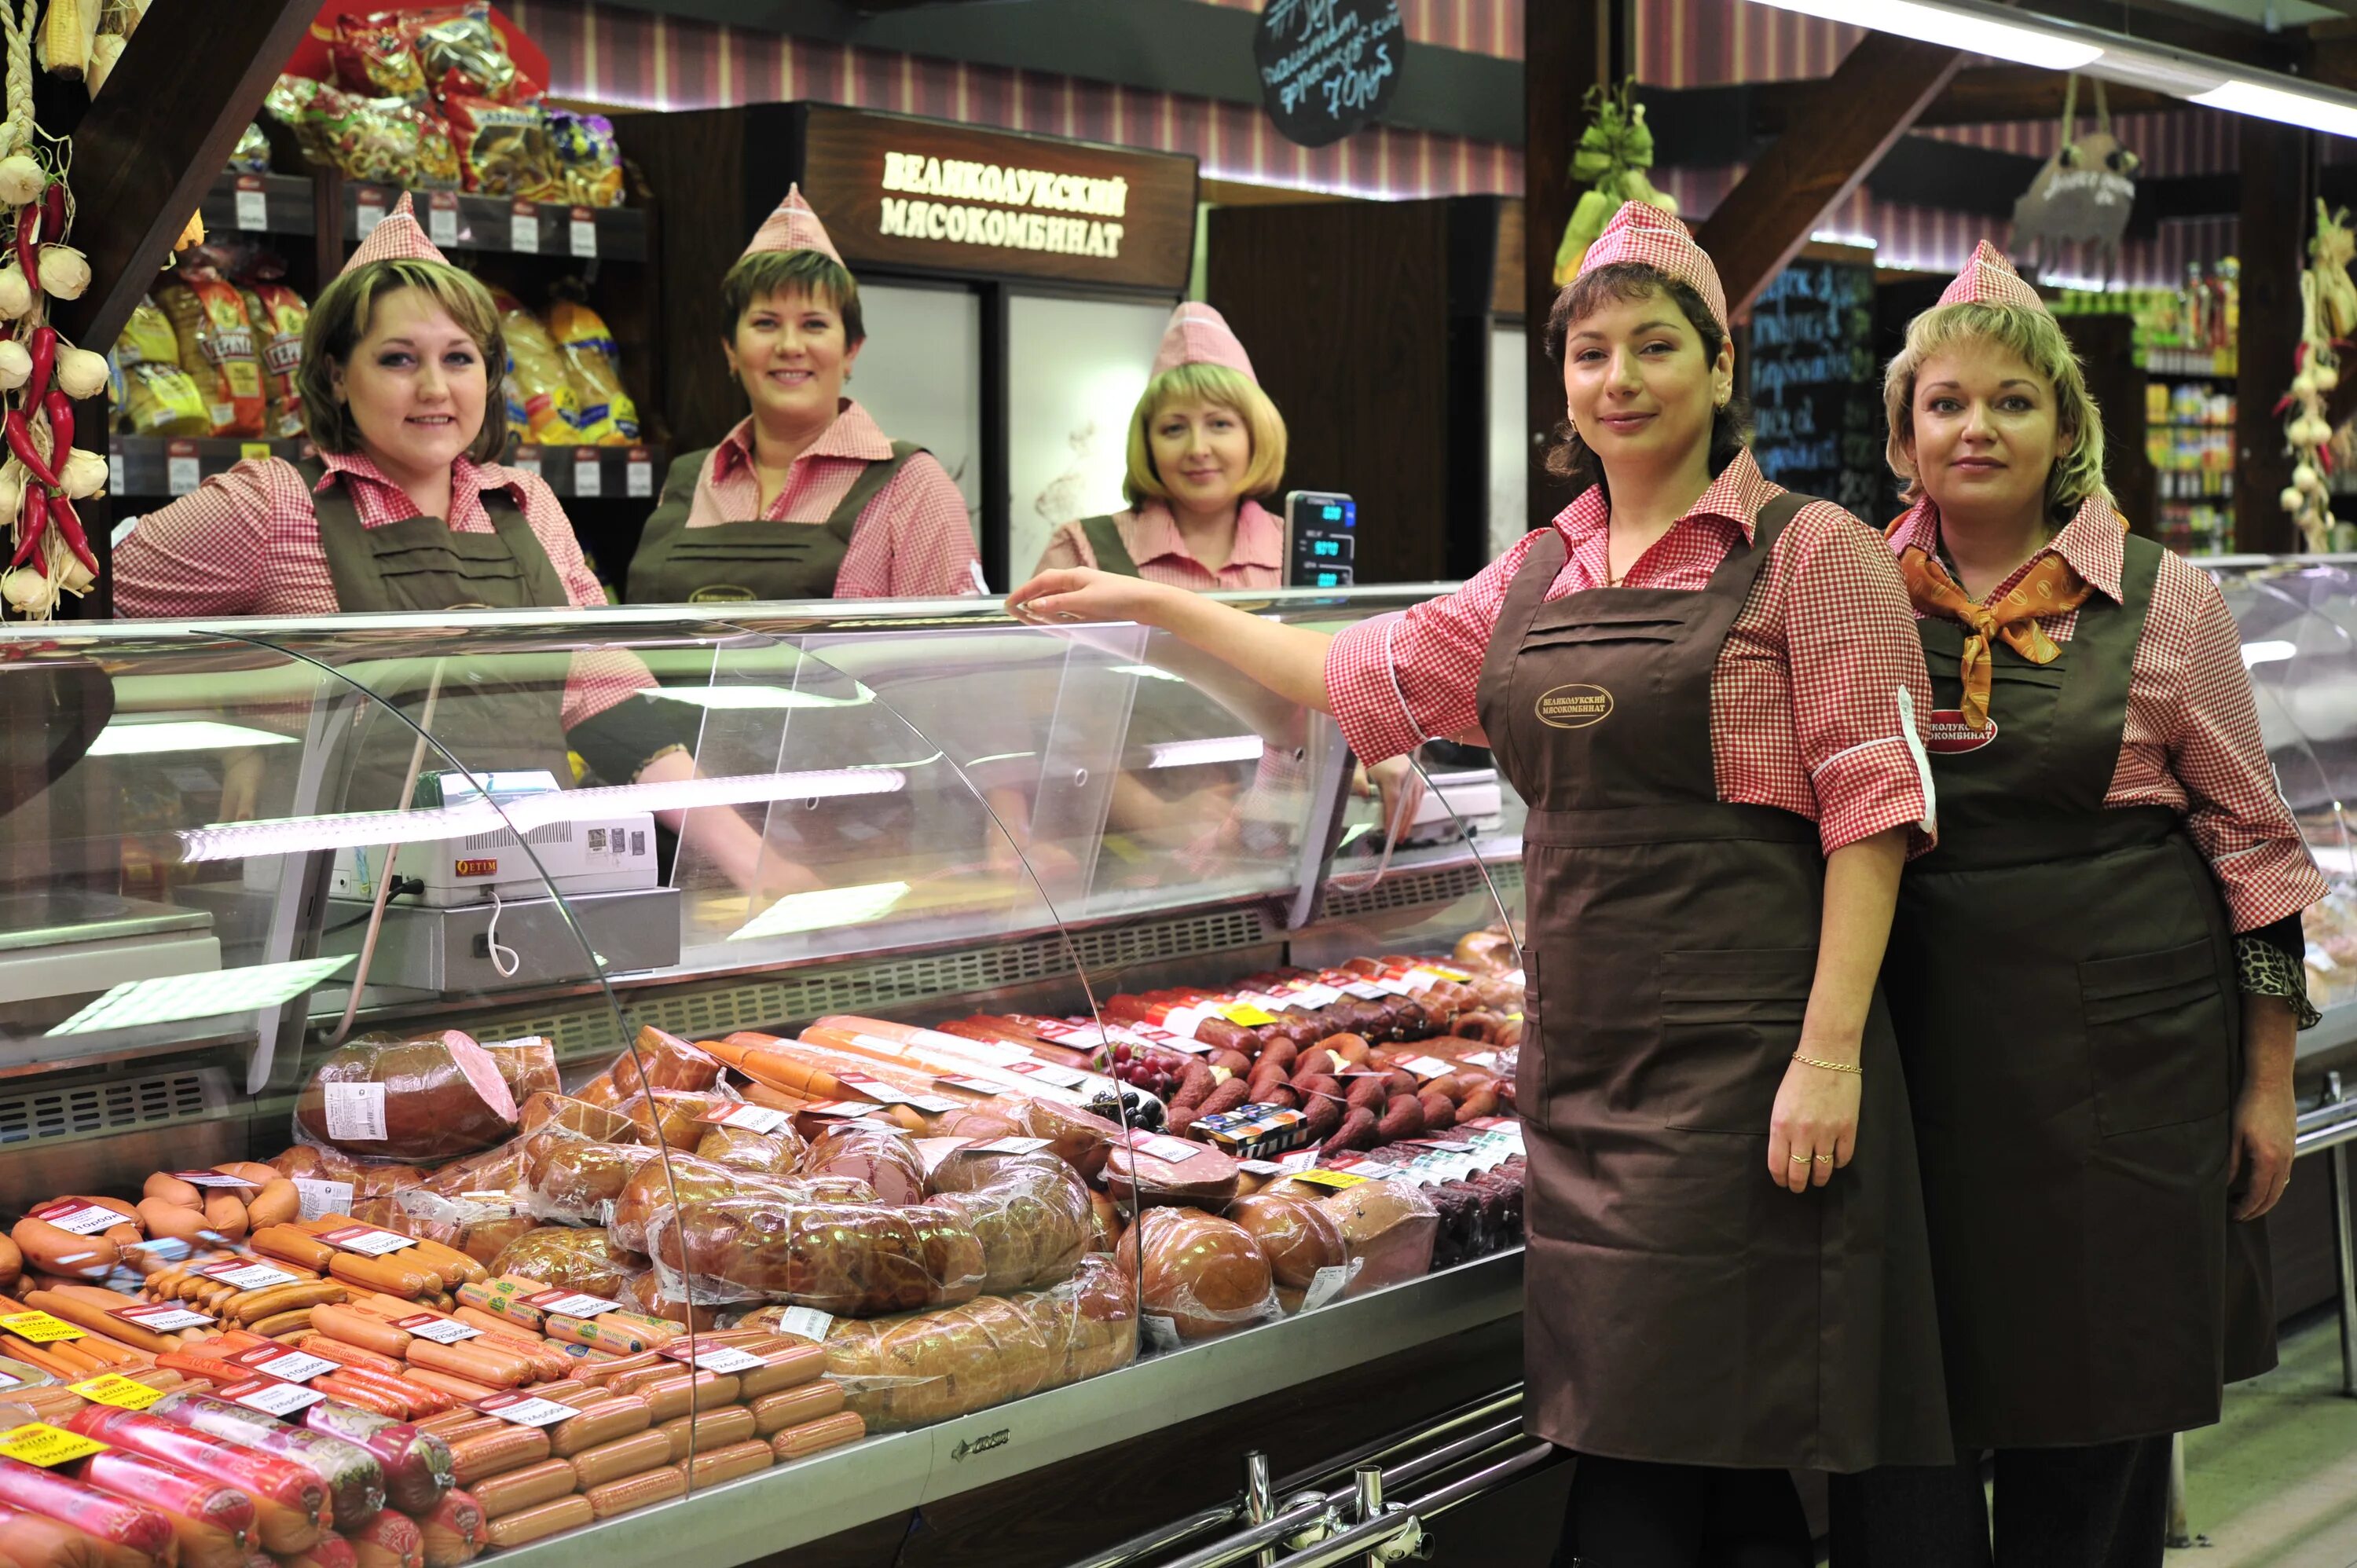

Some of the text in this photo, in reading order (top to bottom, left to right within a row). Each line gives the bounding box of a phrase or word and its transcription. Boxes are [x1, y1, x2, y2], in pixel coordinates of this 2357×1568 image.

[882, 152, 1128, 218] ВЕЛИКОЛУКСКИЙ
[879, 196, 1124, 258] МЯСОКОМБИНАТ
[1542, 694, 1606, 706] ВЕЛИКОЛУКСКИЙ
[1542, 704, 1605, 715] МЯСОКОМБИНАТ
[68, 1213, 120, 1233] 210р00к
[283, 1360, 327, 1378] 210р00к
